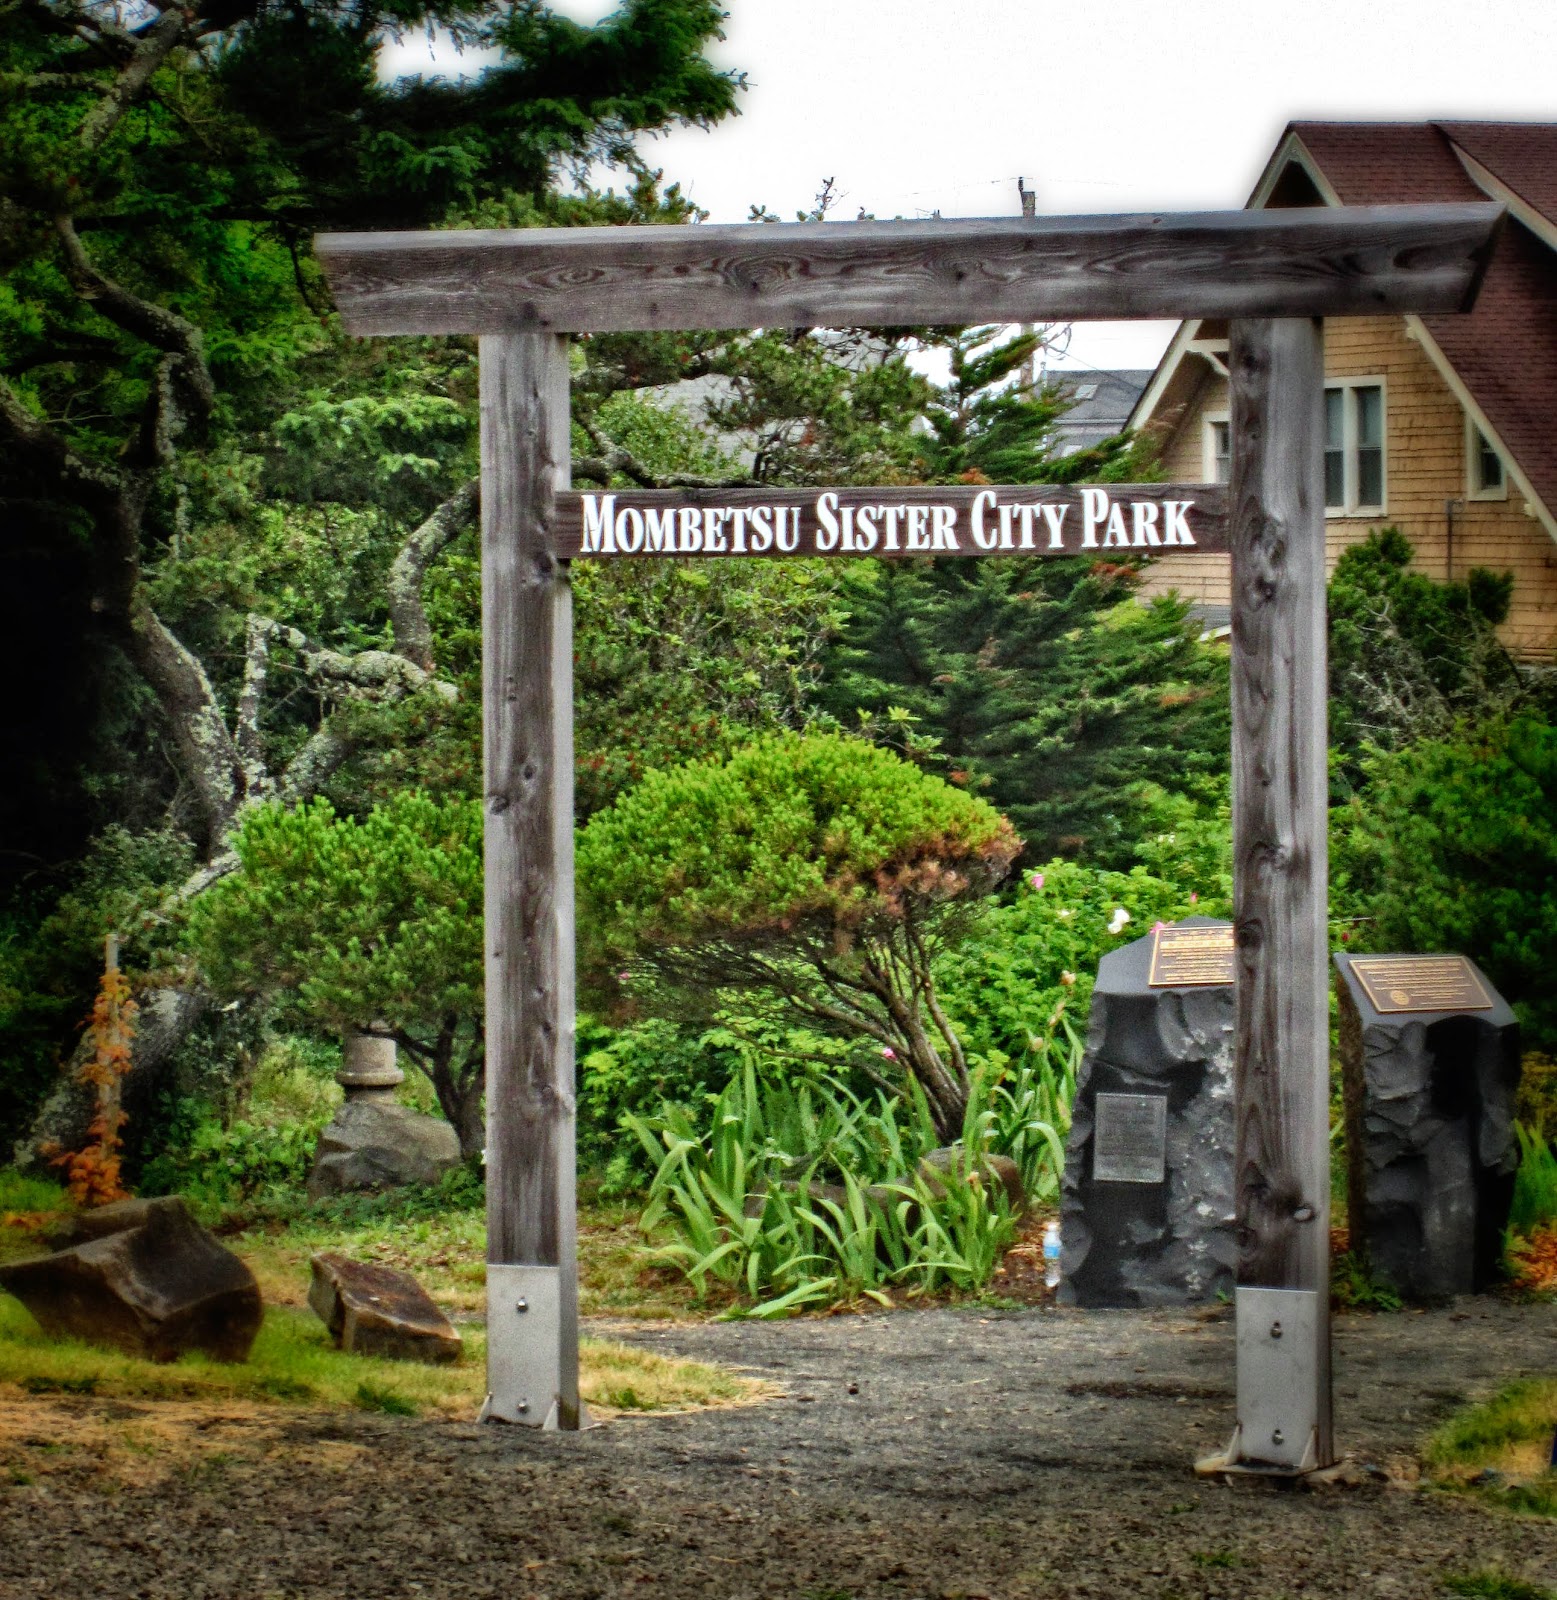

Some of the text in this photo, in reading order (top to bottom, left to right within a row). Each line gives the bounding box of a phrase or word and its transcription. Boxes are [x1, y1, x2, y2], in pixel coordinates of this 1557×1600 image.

[580, 488, 1197, 553] MOMBETSU SISTER CITY PARK
